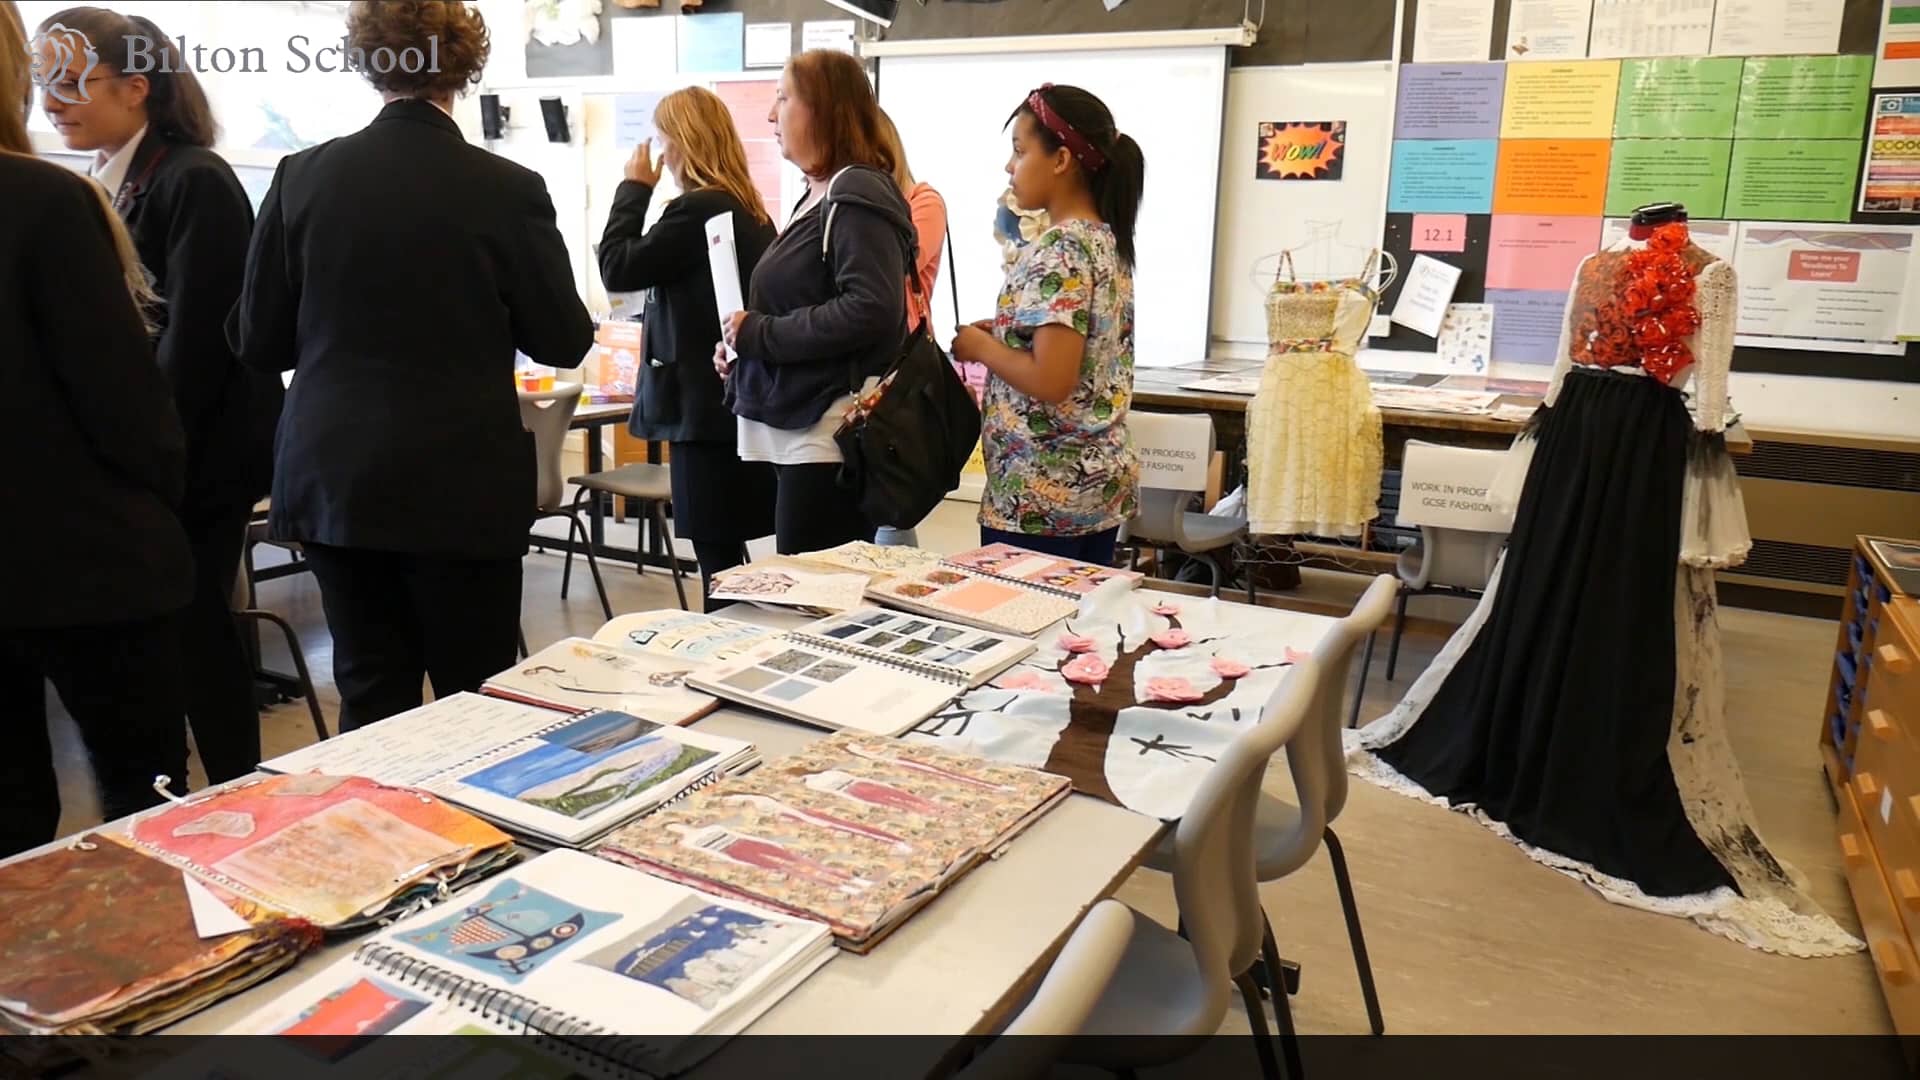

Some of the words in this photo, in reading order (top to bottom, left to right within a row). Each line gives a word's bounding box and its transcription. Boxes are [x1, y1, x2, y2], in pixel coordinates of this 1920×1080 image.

[1271, 140, 1327, 161] WOW!
[1424, 228, 1453, 242] 12.1
[1140, 448, 1150, 456] IN
[1152, 448, 1196, 459] PROGRESS
[1146, 462, 1183, 472] FASHION
[1411, 482, 1440, 493] WORK
[1442, 484, 1455, 494] IN
[1456, 486, 1488, 496] PROG
[1422, 497, 1447, 508] GCSE
[1449, 500, 1492, 512] FASHION
